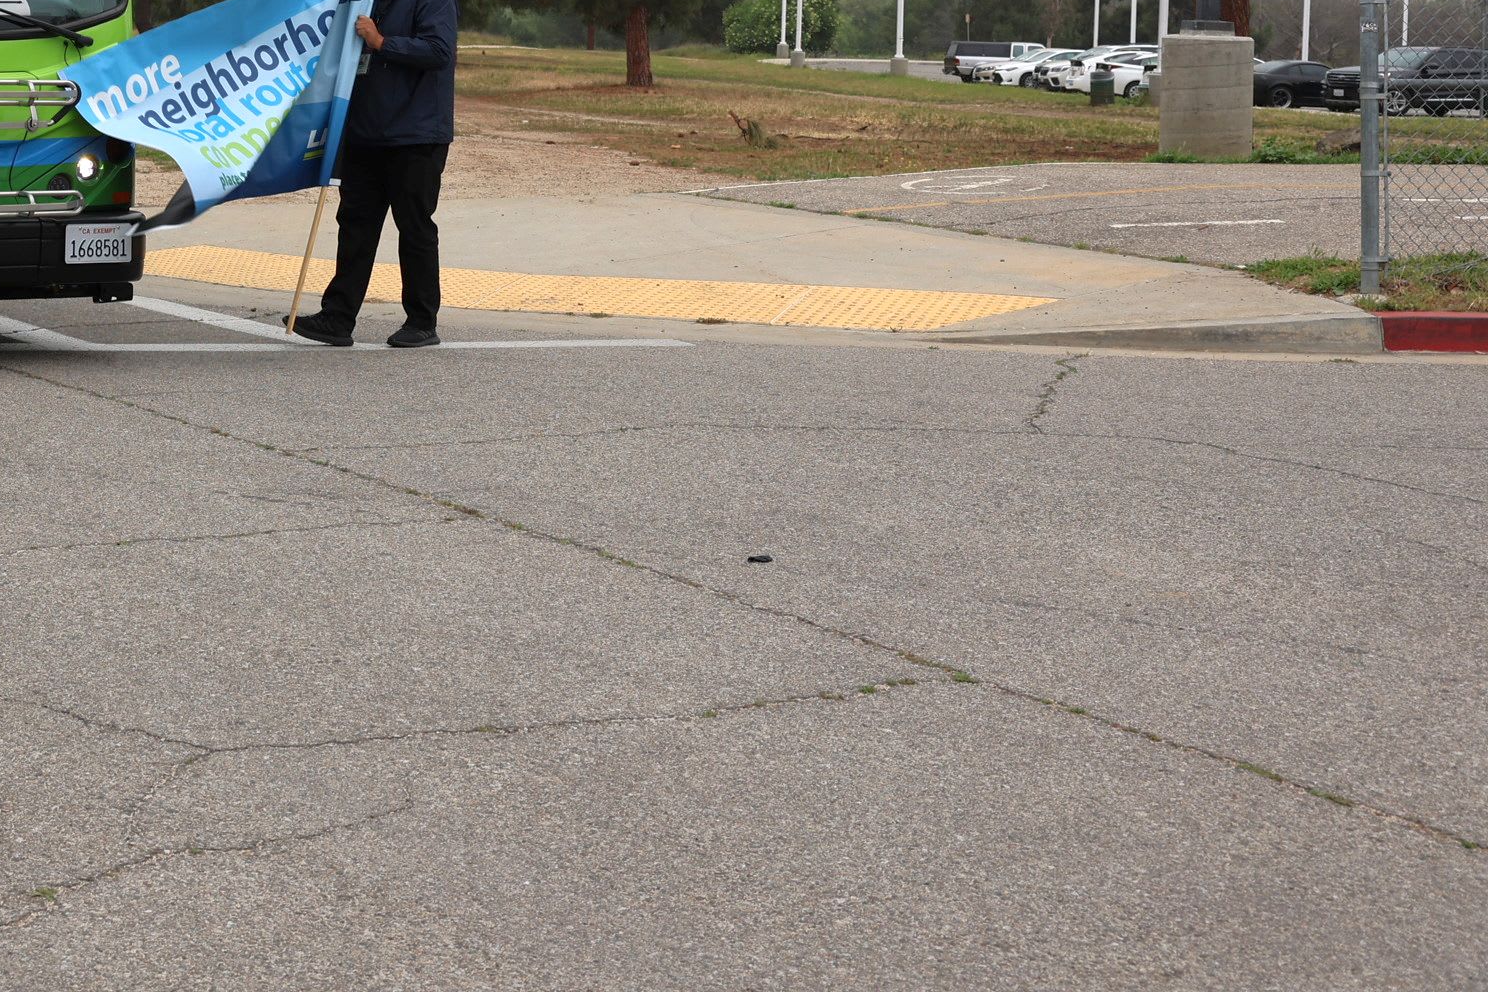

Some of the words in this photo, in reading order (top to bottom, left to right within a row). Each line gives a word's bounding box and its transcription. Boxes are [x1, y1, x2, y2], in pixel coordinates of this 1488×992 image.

[86, 54, 183, 124] more
[200, 108, 289, 169] conne
[70, 239, 127, 258] 1668581
